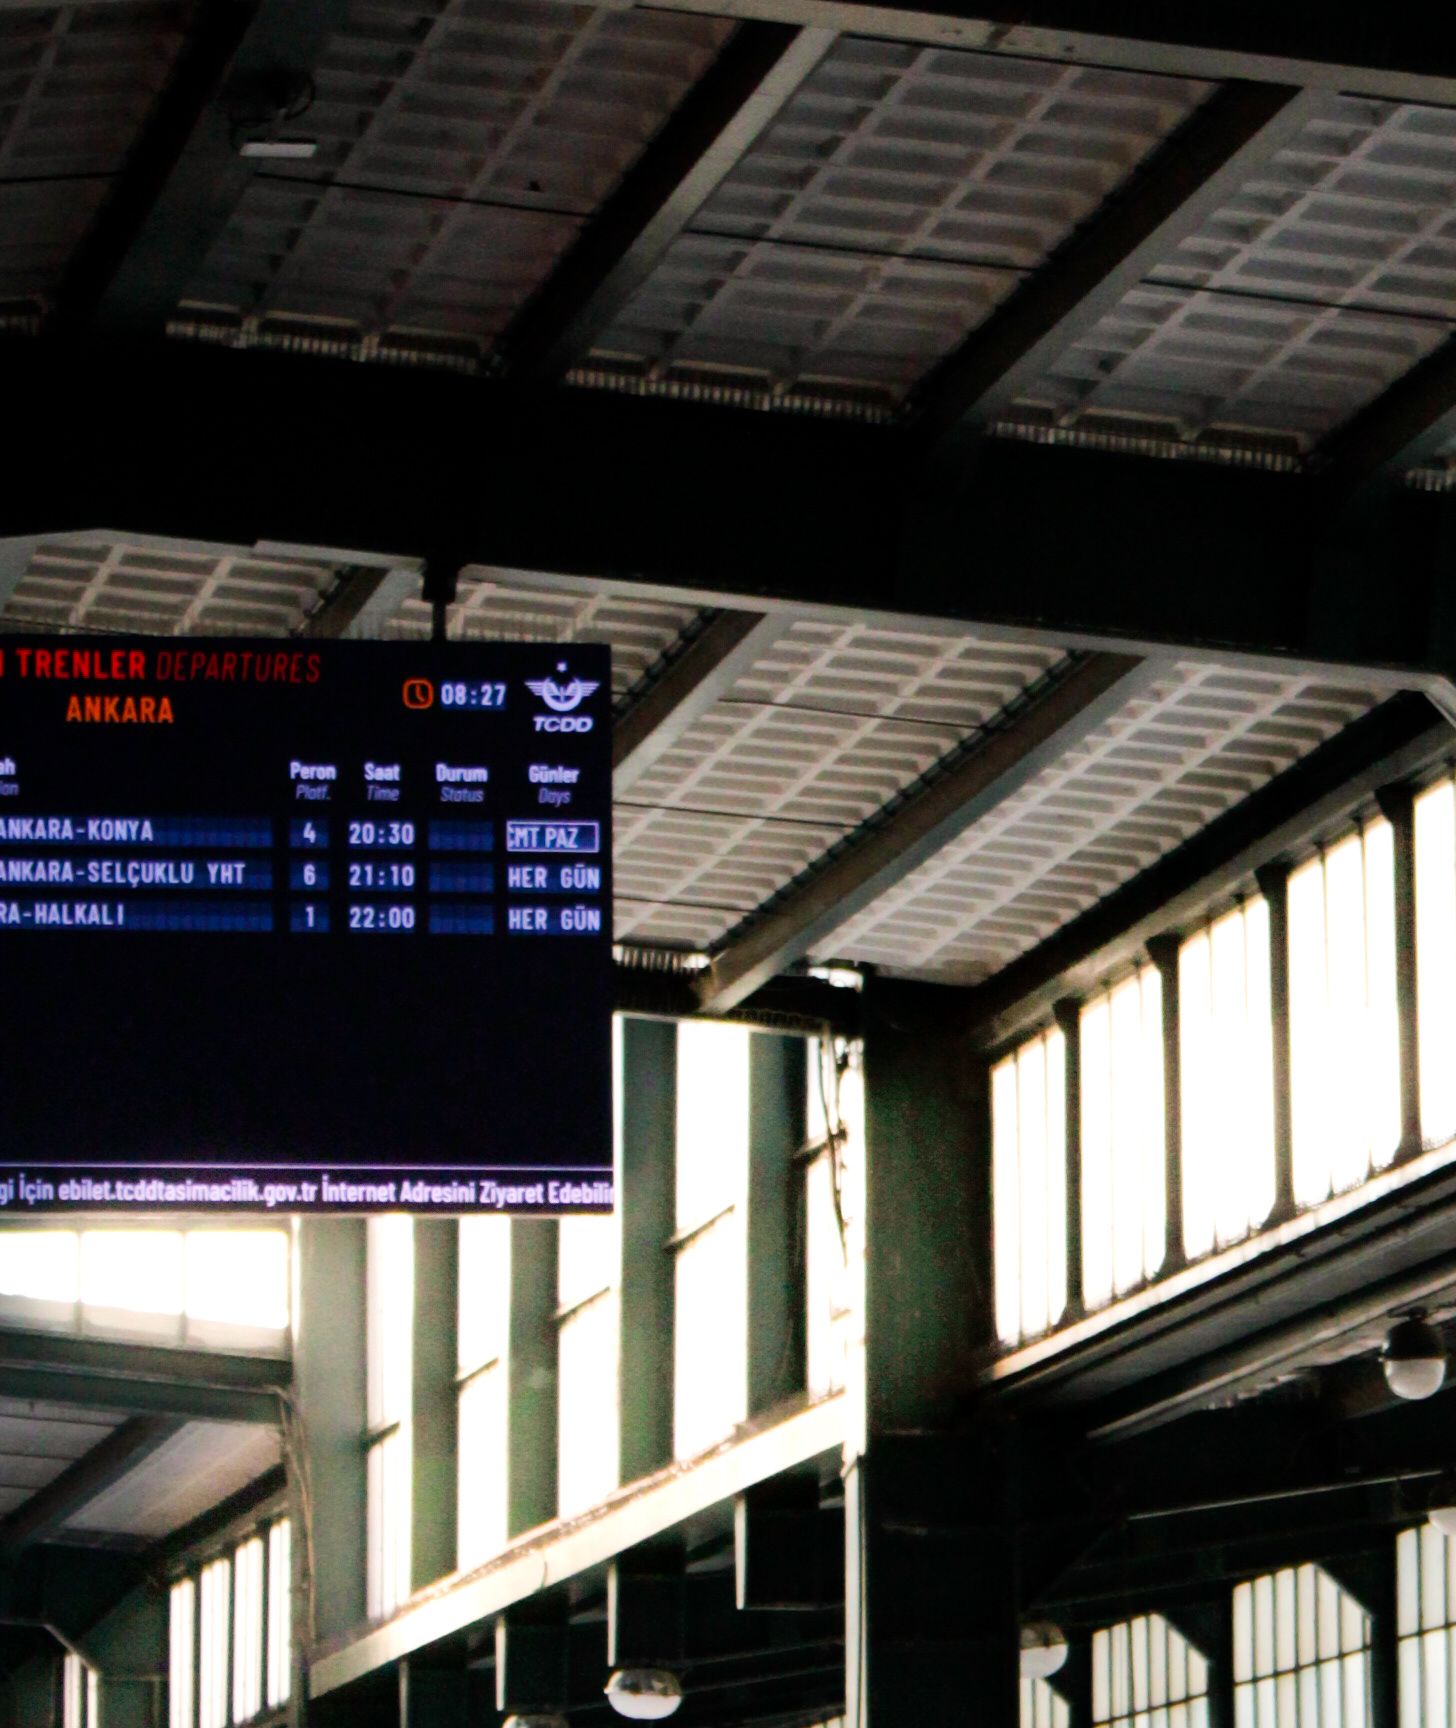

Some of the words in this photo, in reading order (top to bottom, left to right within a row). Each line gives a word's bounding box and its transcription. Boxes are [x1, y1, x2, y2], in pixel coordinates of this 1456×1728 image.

[16, 648, 146, 680] TRENLER
[156, 651, 321, 683] DEPARTURES
[441, 682, 507, 706] 08:27
[66, 695, 174, 723] ANKARA
[533, 715, 594, 733] TCDD
[290, 761, 336, 780] Peron
[364, 762, 400, 781] Saat
[436, 763, 488, 782] Durum
[529, 764, 579, 784] Günler
[296, 784, 331, 800] Platf.
[367, 785, 400, 801] Time
[440, 786, 484, 802] Status
[538, 787, 571, 807] Days
[303, 822, 316, 843] 4
[349, 823, 415, 845] 20:30
[545, 827, 578, 849] PAZ
[207, 862, 245, 884] YHT
[303, 864, 316, 886] 6
[349, 864, 415, 886] 21:10
[508, 866, 547, 888] HER
[560, 863, 600, 889] GÜN
[305, 906, 315, 927] 1
[349, 907, 415, 929] 22:00
[508, 909, 548, 930] HER
[560, 905, 600, 931] GÜN
[19, 1174, 54, 1204] İçin
[321, 1174, 396, 1202] İnternet
[401, 1179, 476, 1204] Adresini
[479, 1181, 544, 1208] Ziyaret
